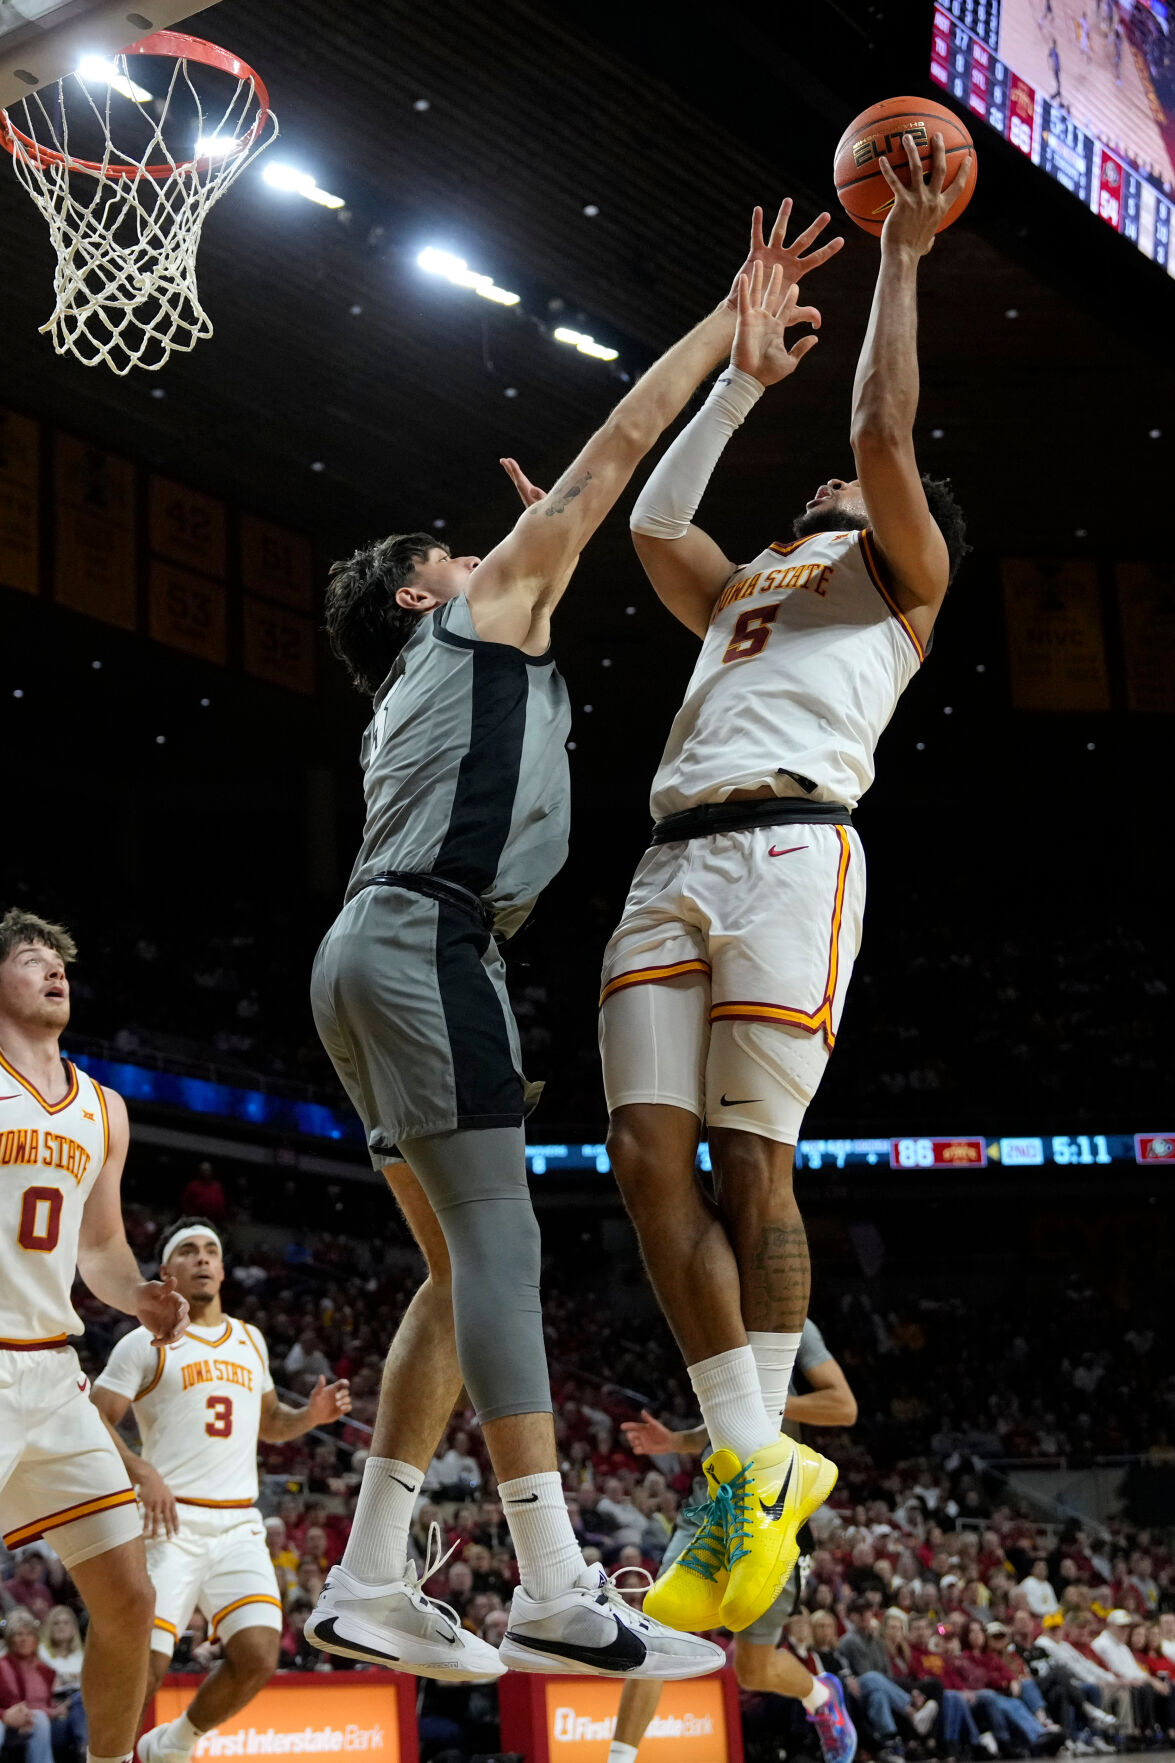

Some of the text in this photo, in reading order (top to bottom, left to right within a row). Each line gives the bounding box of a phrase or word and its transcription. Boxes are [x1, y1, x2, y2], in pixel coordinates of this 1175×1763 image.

[955, 27, 969, 50] 17
[1100, 190, 1119, 226] 54
[760, 563, 834, 598] STATE
[721, 602, 783, 665] 5
[42, 1130, 91, 1187] STATE
[898, 1138, 935, 1168] 86
[1052, 1135, 1112, 1165] 5:11
[17, 1185, 65, 1254] 0
[181, 1359, 253, 1392] IOWA STATE
[205, 1395, 233, 1439] 3
[194, 1724, 385, 1758] First Interstate Bank
[683, 1713, 714, 1736] Bank
